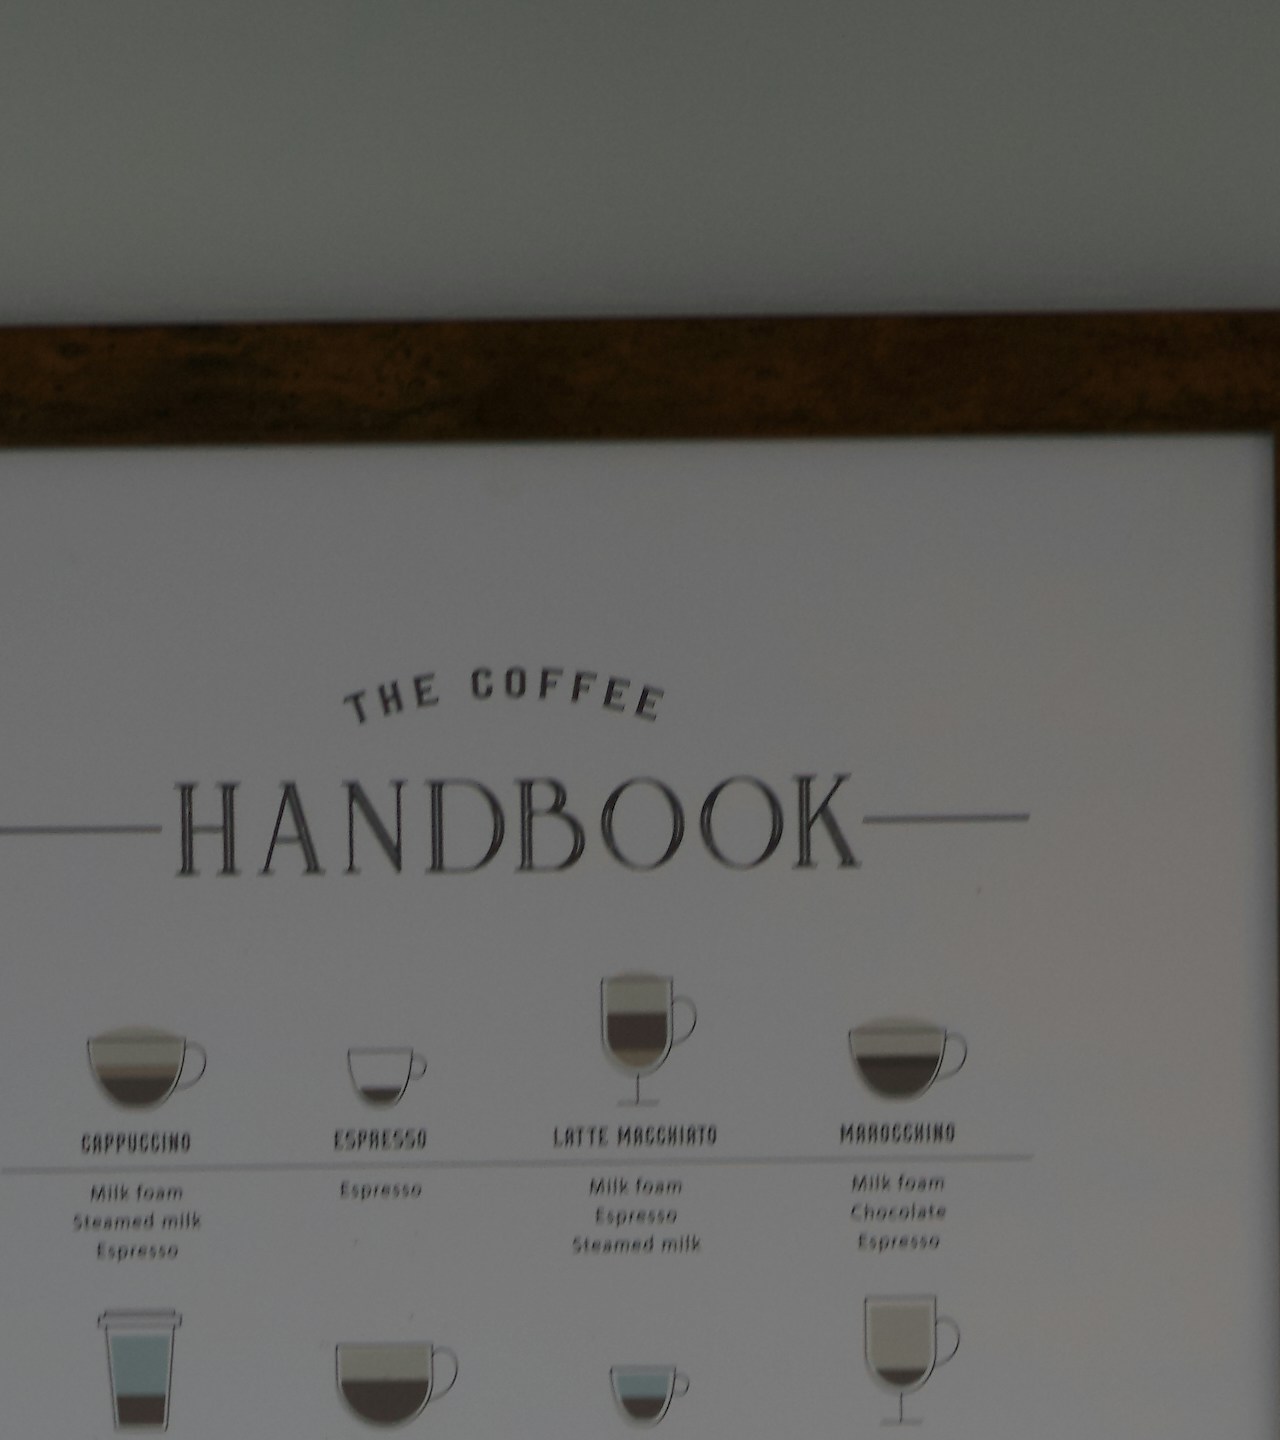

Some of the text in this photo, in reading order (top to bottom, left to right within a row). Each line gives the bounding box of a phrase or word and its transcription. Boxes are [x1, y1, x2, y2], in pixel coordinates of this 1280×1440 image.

[343, 666, 665, 725] THE COFFEE
[173, 773, 862, 878] HANDBOOK
[80, 1132, 191, 1154] CAPPUCCINO
[333, 1128, 427, 1151] ESPRESSO
[553, 1124, 718, 1147] LATTE MACCHIATO
[839, 1122, 956, 1144] MAROCCHINO
[90, 1183, 184, 1202] Milk foam
[339, 1180, 423, 1201] Espresso
[589, 1177, 683, 1196] Milk foam
[851, 1173, 945, 1192] Milk foam
[73, 1211, 201, 1232] Steamed milk
[595, 1206, 678, 1228] Espresso
[850, 1202, 947, 1221] Chocolate
[96, 1241, 179, 1263] Espresso
[572, 1234, 701, 1254] Steamed milk
[857, 1232, 941, 1254] Espresso
